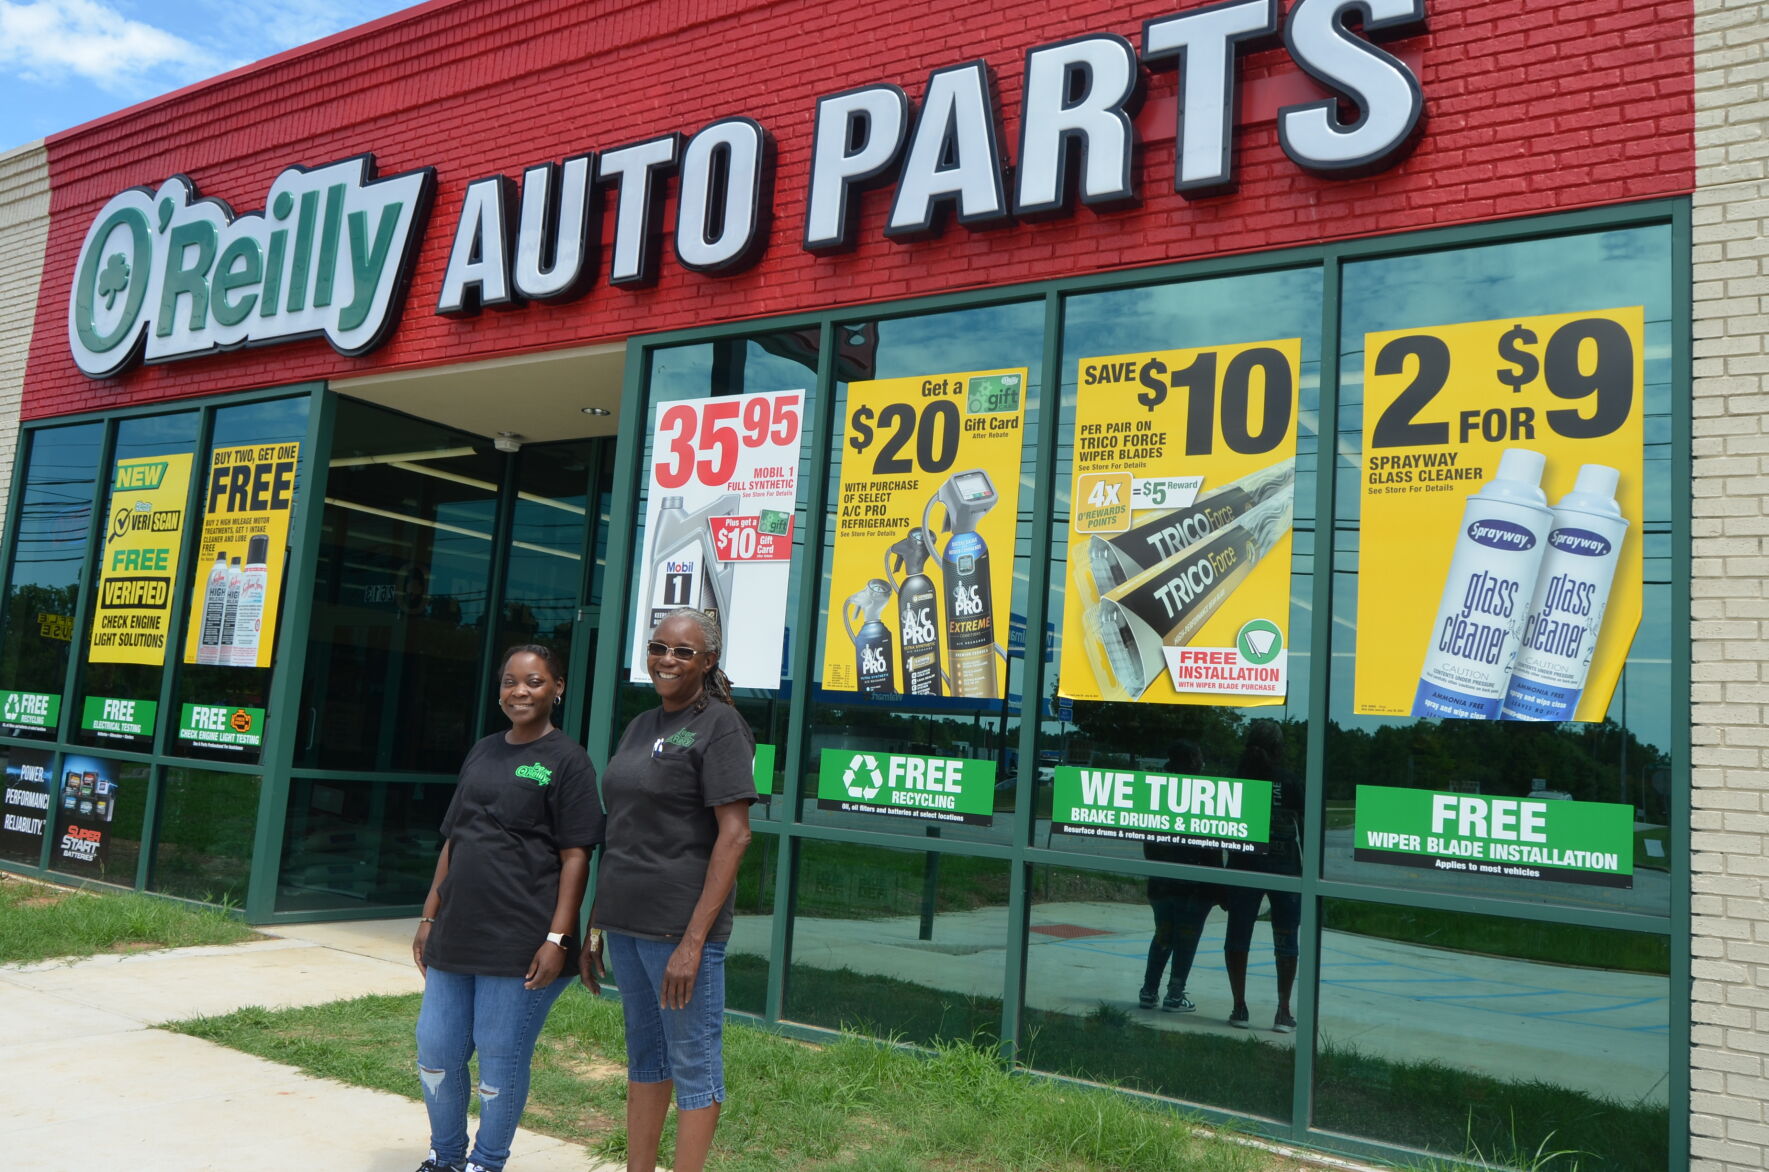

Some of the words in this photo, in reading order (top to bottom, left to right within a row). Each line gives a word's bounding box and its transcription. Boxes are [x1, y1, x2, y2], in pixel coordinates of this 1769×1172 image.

[73, 180, 408, 356] O'Reilly
[437, 120, 762, 312] AUTO
[803, 0, 1424, 250] PARTS
[1496, 317, 1634, 440] $9
[922, 379, 949, 397] Get
[953, 381, 963, 394] a
[1371, 334, 1451, 449] 2
[987, 388, 1018, 412] gift
[1084, 361, 1137, 386] SAVE
[1137, 347, 1293, 457] $10
[964, 417, 986, 432] Gift
[989, 415, 1019, 431] Card
[1081, 423, 1102, 435] PER
[1107, 422, 1131, 434] PAIR
[1136, 420, 1152, 433] ON
[1459, 406, 1536, 444] FOR
[849, 399, 961, 475] $20
[988, 431, 1009, 439] Rebate
[1080, 436, 1118, 450] TRICO
[1123, 433, 1167, 447] FORCE
[214, 451, 232, 466] BUY
[234, 448, 255, 464] TWO,
[258, 447, 276, 461] GET
[277, 445, 297, 459] ONE
[1079, 450, 1114, 463] WIPER
[1118, 447, 1163, 460] BLADES
[1369, 452, 1459, 471] SPRAYWAY
[753, 467, 785, 479] MOBIL
[788, 466, 794, 477] 1
[1092, 463, 1109, 471] Store
[1111, 462, 1121, 470] For
[1123, 461, 1146, 469] Details
[116, 463, 164, 489] NEW
[1167, 480, 1198, 490] Reward
[1368, 470, 1413, 485] GLASS
[1418, 467, 1483, 482] CLEANER
[208, 461, 294, 514] FREE
[727, 481, 746, 492] FULL
[749, 479, 794, 491] SYNTHETIC
[845, 482, 867, 493] WITH
[870, 480, 919, 491] PURCHASE
[1368, 486, 1383, 495] See
[1384, 485, 1407, 494] Store
[1409, 484, 1422, 493] For
[1425, 483, 1454, 492] Details
[844, 494, 855, 504] OF
[858, 492, 891, 504] SELECT
[842, 506, 862, 517] A/C
[865, 505, 887, 516] PRO
[725, 518, 739, 527] Plus
[740, 518, 752, 528] get
[770, 520, 788, 534] gift
[841, 517, 910, 530] REFRIGERANTS
[1087, 516, 1117, 528] POINTS
[718, 527, 757, 559] $10
[760, 536, 773, 545] Gift
[1471, 522, 1529, 549] Sprayway
[1551, 530, 1605, 554] Sprayway
[202, 544, 216, 552] FREE
[757, 544, 774, 554] Card
[111, 548, 170, 572] FREE
[666, 562, 694, 573] Mobil
[103, 580, 167, 606] VERIFIED
[672, 575, 682, 604] 1
[1462, 570, 1520, 618] glass
[1543, 573, 1596, 618] glass
[955, 599, 983, 616] PRO
[101, 615, 128, 629] CHECK
[130, 615, 161, 630] ENGINE
[950, 617, 991, 633] EXTREME
[94, 633, 117, 647] LIGHT
[118, 633, 164, 648] SOLUTIONS
[903, 624, 935, 646] PRO
[1438, 613, 1510, 666] cleaner
[1522, 612, 1587, 659] cleaner
[862, 659, 886, 674] PRO
[1180, 651, 1237, 665] FREE
[1525, 656, 1569, 672] CAUTION
[1179, 666, 1280, 682] INSTALLATION
[1442, 662, 1490, 681] CAUTION
[1241, 683, 1276, 691] PURCHASE
[1517, 682, 1549, 697] AMMONIA
[1551, 691, 1566, 699] FREE
[21, 694, 50, 715] FREE
[1432, 691, 1467, 706] AMMONIA
[1469, 701, 1485, 710] FREE
[103, 699, 136, 722] FREE
[191, 706, 228, 731] FREE
[93, 720, 120, 731] ELECTRICAL
[121, 722, 142, 733] TESTING
[180, 729, 198, 739] CHECK
[199, 730, 218, 741] ENGINE
[219, 732, 235, 743] LIGHT
[236, 734, 260, 745] TESTING
[21, 764, 45, 783] POWER.
[888, 756, 964, 794] FREE
[892, 791, 956, 810] RECYCLING
[1080, 770, 1135, 809] WE
[1145, 775, 1243, 819] TURN
[859, 804, 875, 813] filters
[876, 806, 887, 814] and
[888, 807, 912, 817] batteries
[920, 810, 937, 819] select
[938, 811, 964, 822] locations
[1431, 794, 1547, 843] FREE
[1071, 807, 1116, 825] BRAKE
[1120, 811, 1170, 831] DRUMS
[1174, 817, 1186, 832] &
[1190, 818, 1248, 838] ROTORS
[67, 825, 102, 842] SUPER
[1063, 825, 1095, 836] Resurface
[1096, 827, 1117, 838] drums
[1118, 830, 1124, 838] &
[1125, 831, 1145, 840] rotors
[1147, 833, 1155, 841] as
[1156, 834, 1170, 843] part
[1172, 835, 1180, 843] of
[1187, 837, 1219, 849] complete
[1221, 840, 1241, 850] brake
[1242, 842, 1255, 853] job
[60, 835, 101, 854] START
[1367, 831, 1421, 852] WIPER
[1427, 837, 1483, 858] BLADE
[1489, 842, 1618, 870] INSTALLATION
[63, 850, 94, 862] BATTERIES
[1435, 859, 1466, 871] Applies
[1468, 862, 1478, 871] to
[1479, 864, 1501, 874] most
[1503, 866, 1540, 878] vehicles
